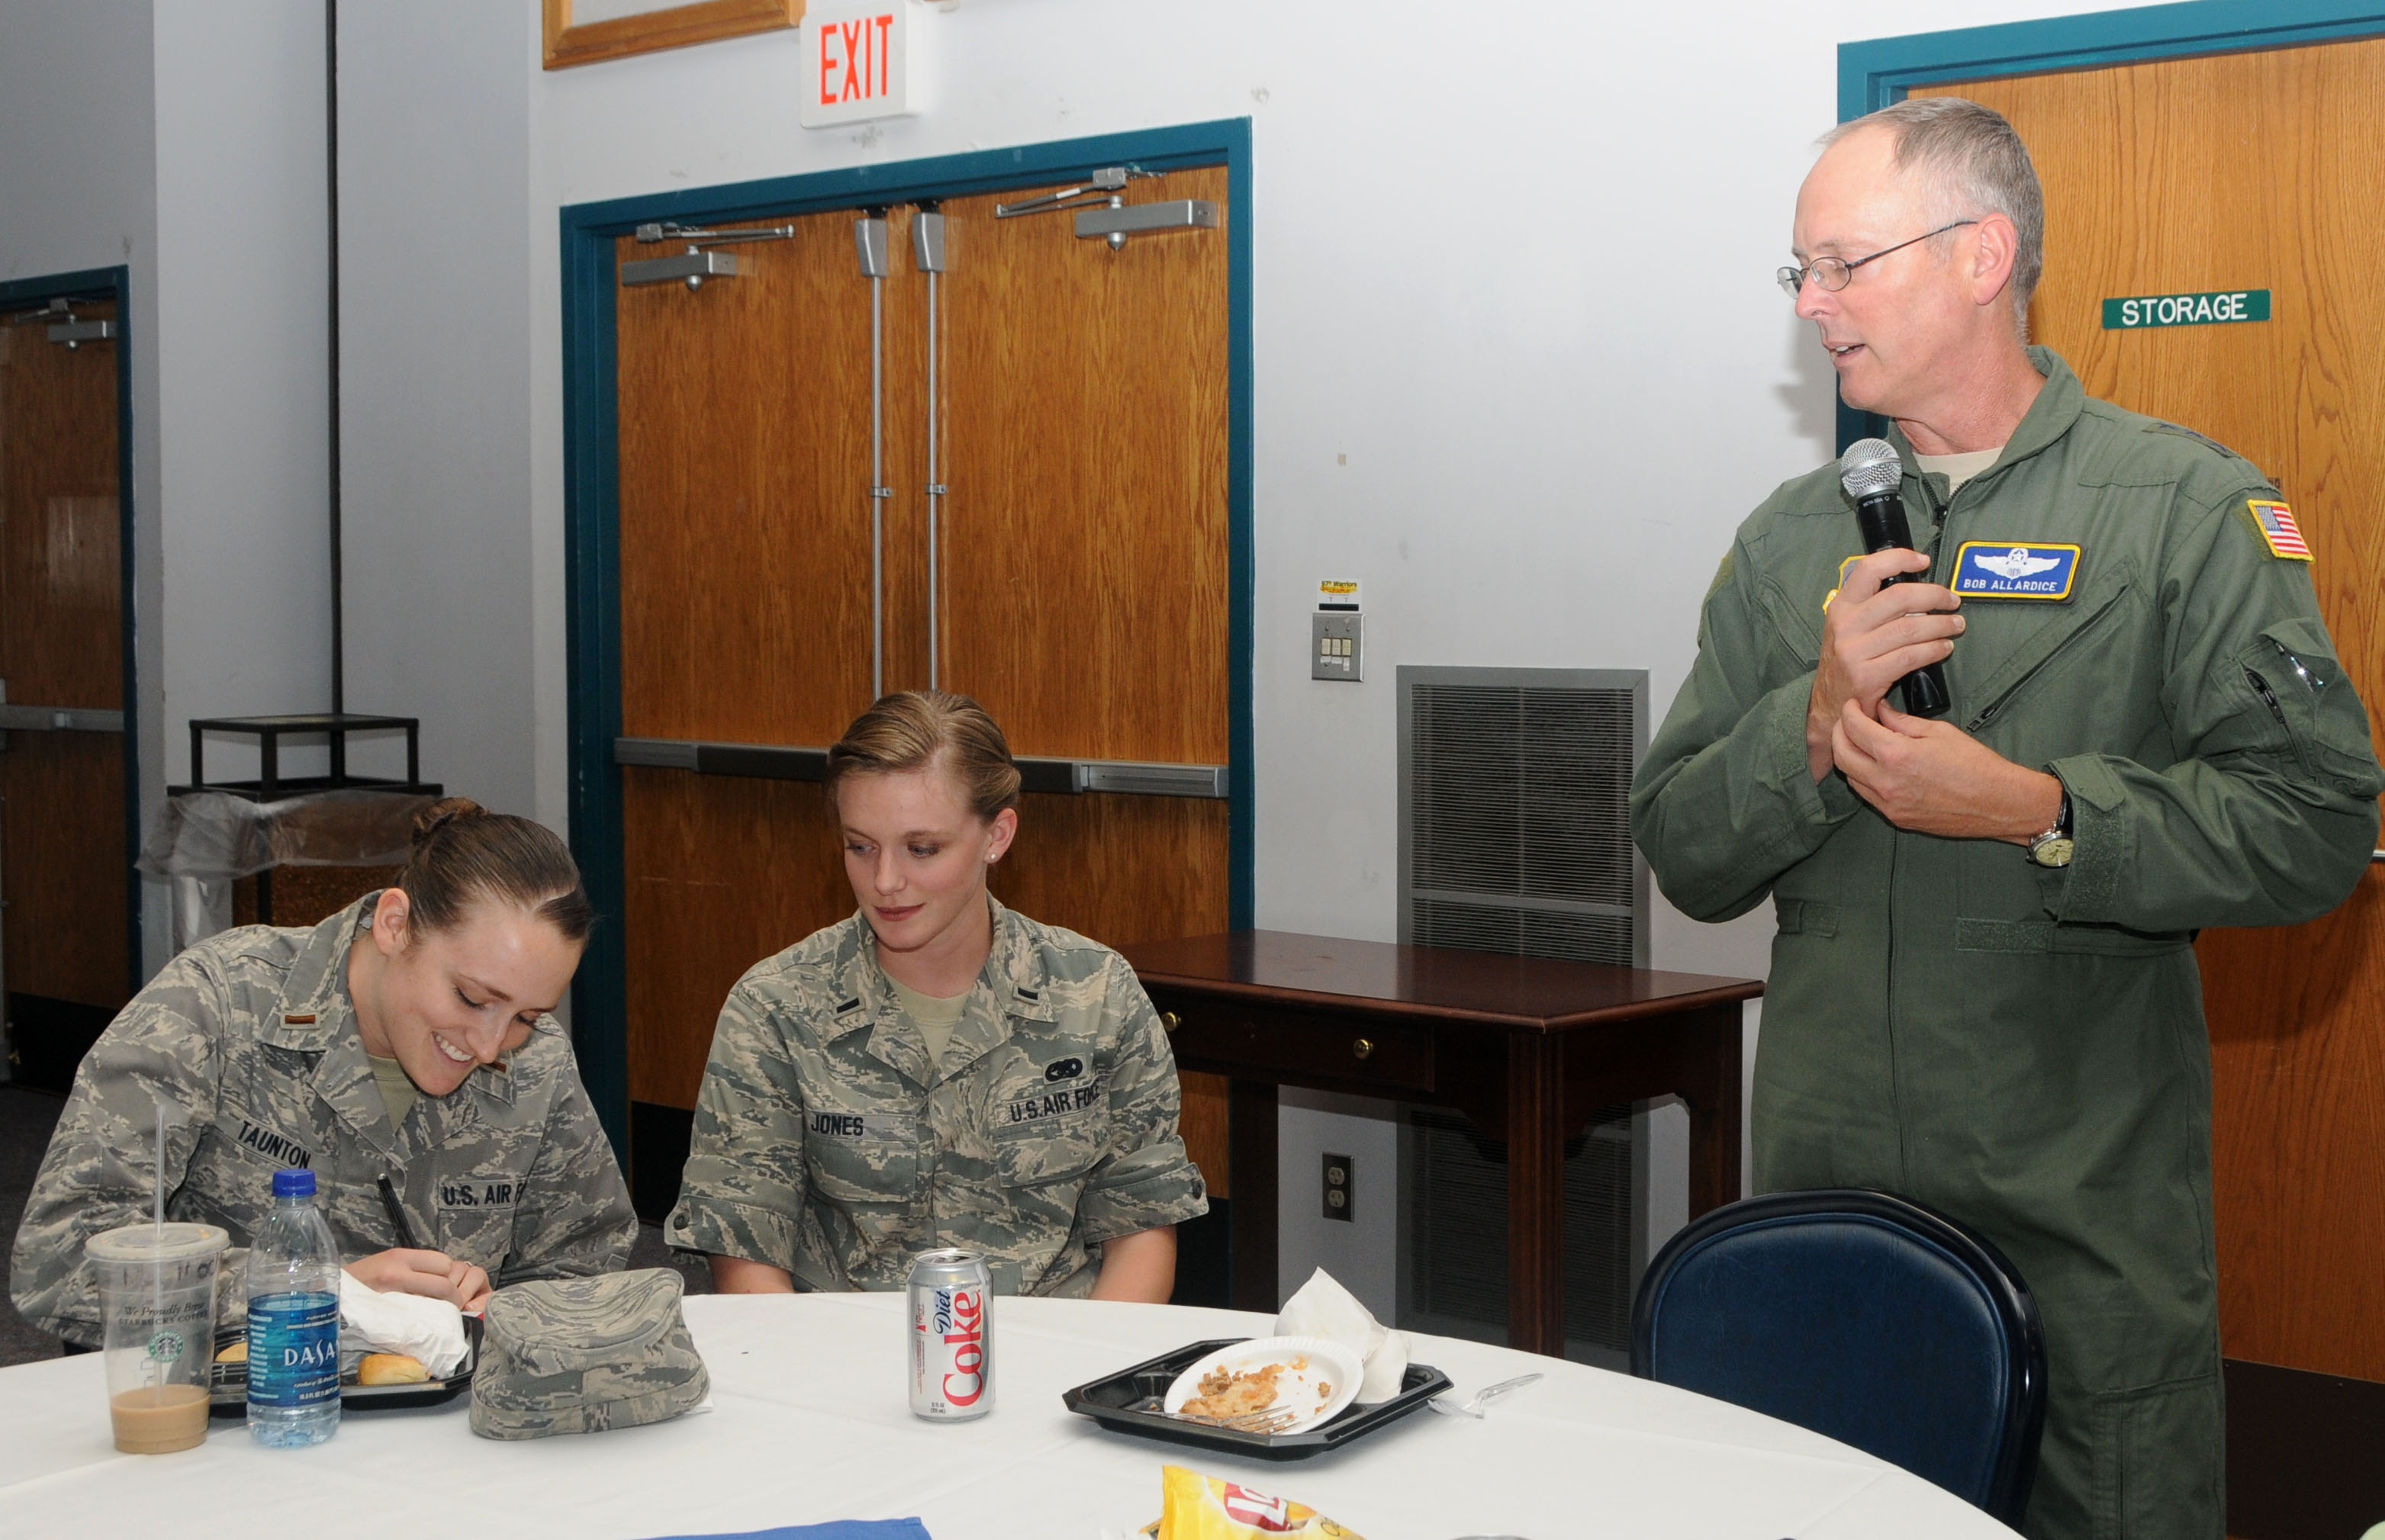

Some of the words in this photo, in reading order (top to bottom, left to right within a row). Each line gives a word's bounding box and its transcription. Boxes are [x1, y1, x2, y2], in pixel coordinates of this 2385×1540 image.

[820, 14, 893, 105] EXIT
[2122, 293, 2248, 326] STORAGE
[1963, 578, 1987, 589] BOB
[1991, 580, 2058, 592] ALLARDICE
[1043, 1092, 1072, 1116] AIR
[810, 1114, 864, 1136] JONES
[238, 1120, 311, 1169] TAUNTON
[443, 1184, 478, 1206] U.S.
[484, 1184, 512, 1204] AIR
[141, 1301, 181, 1317] Proudly
[932, 1290, 952, 1334] Diet
[284, 1339, 340, 1368] DASA
[942, 1289, 983, 1407] Coke
